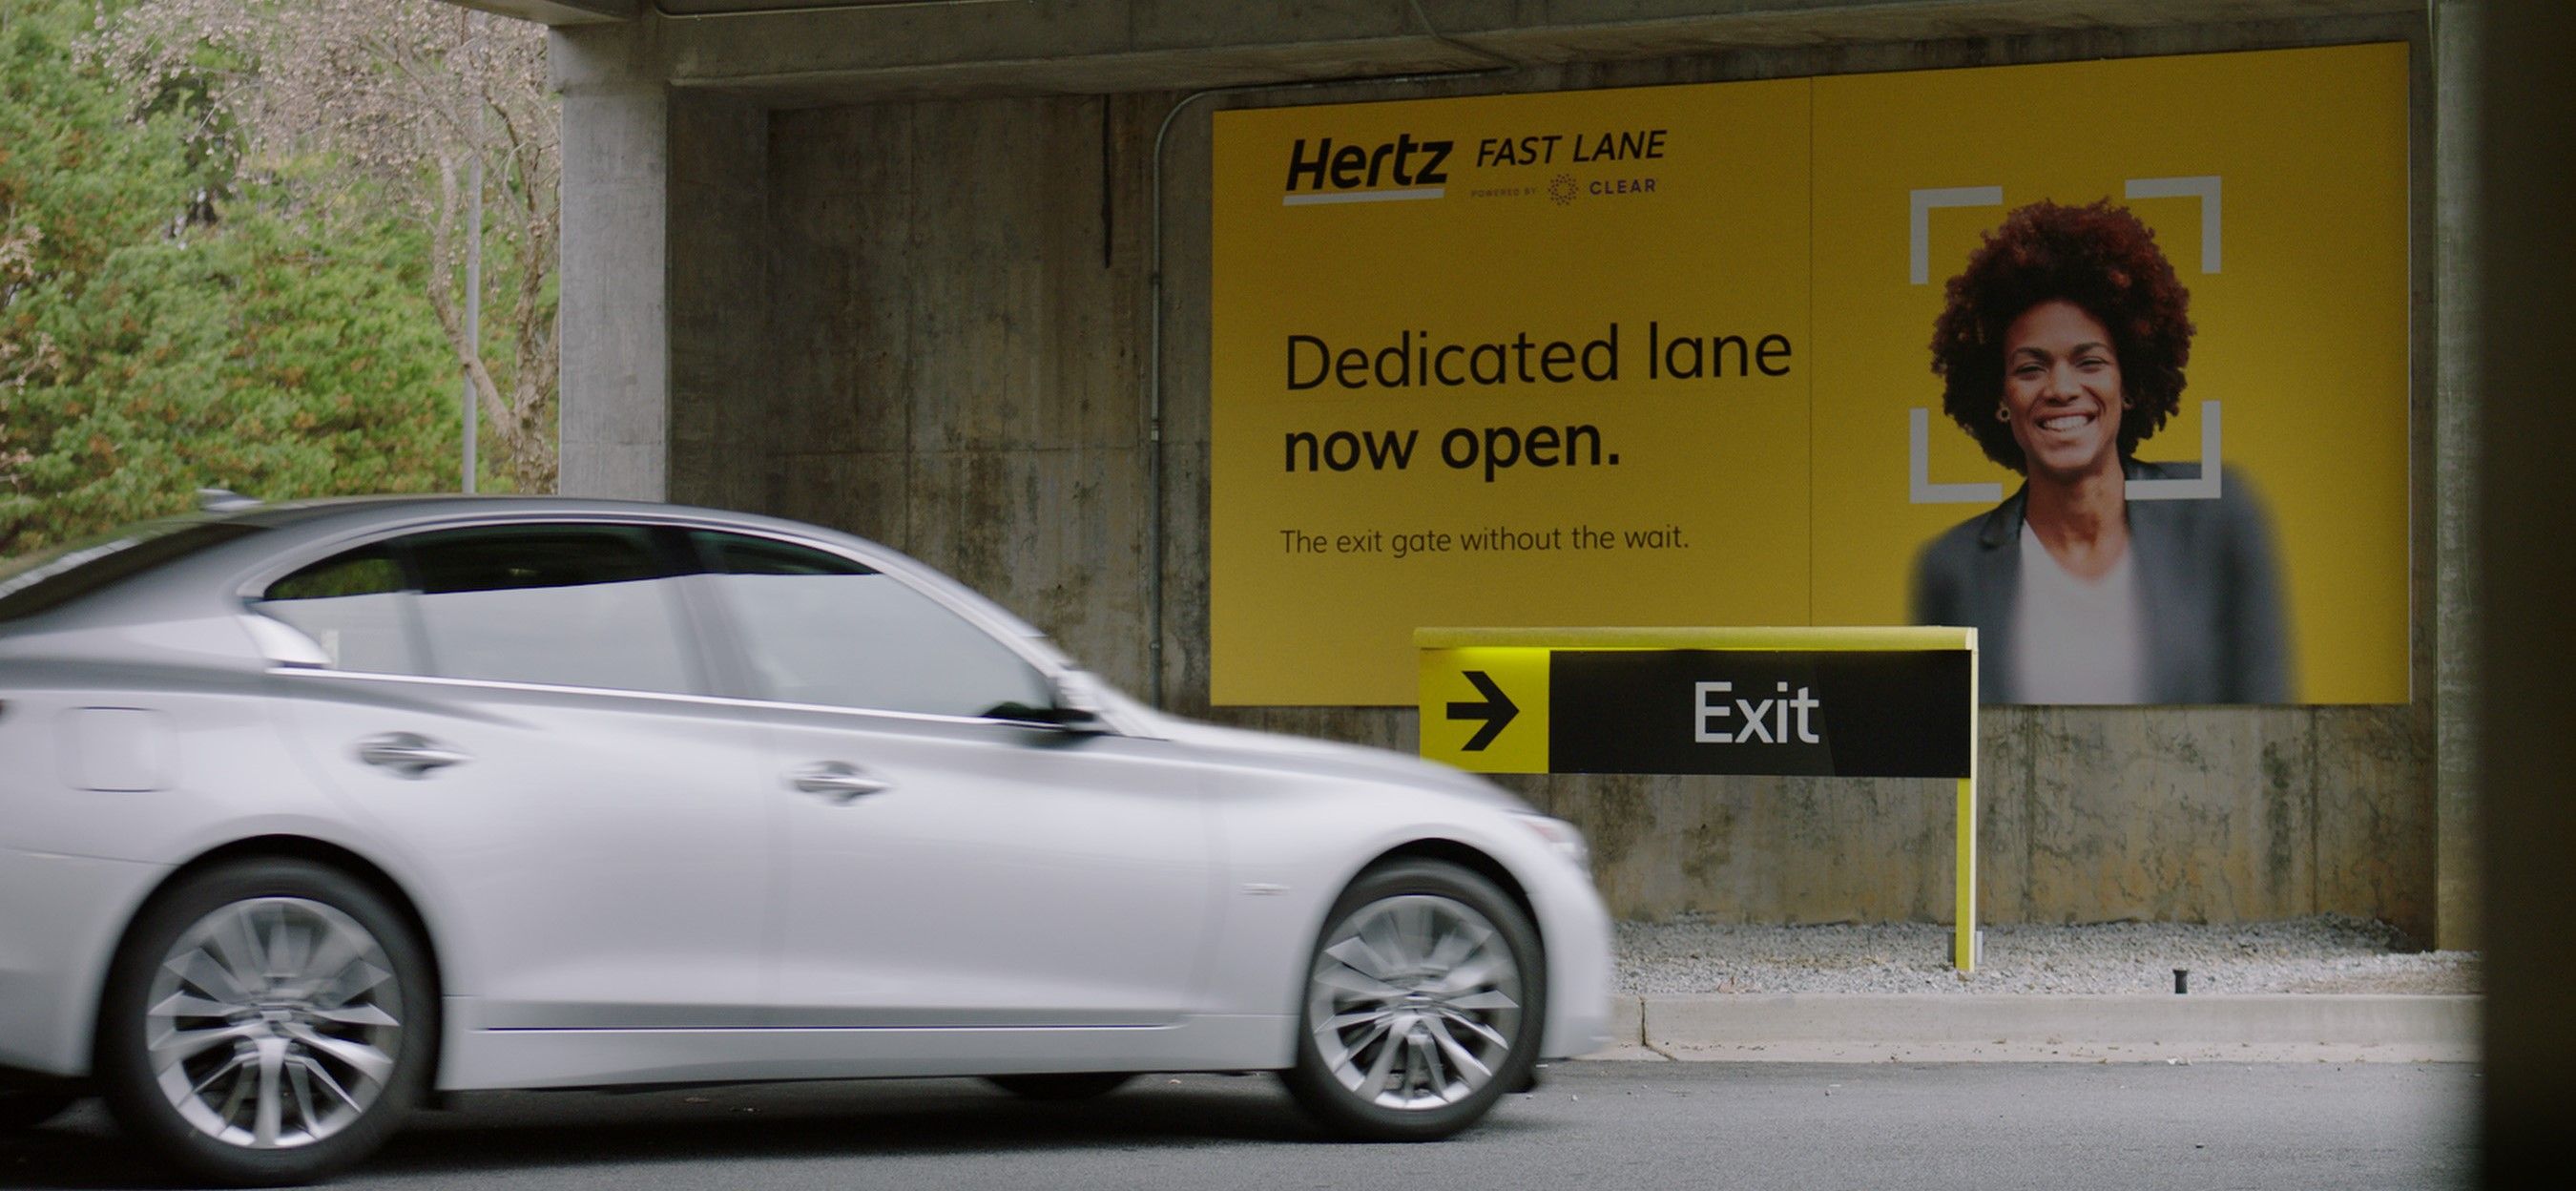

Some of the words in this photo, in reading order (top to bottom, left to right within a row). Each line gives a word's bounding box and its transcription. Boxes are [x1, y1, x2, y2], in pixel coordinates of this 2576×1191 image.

[1285, 134, 1454, 191] Hertz
[1477, 136, 1562, 167] FAST
[1573, 130, 1668, 163] LANE
[1471, 188, 1518, 198] POWERED
[1524, 186, 1537, 197] BY
[1589, 178, 1656, 196] CLEAR
[1286, 324, 1620, 390] Dedicated
[1650, 322, 1793, 380] lane
[1285, 429, 1419, 472] now
[1441, 424, 1620, 482] open.
[1280, 529, 1328, 554] The
[1336, 529, 1383, 554] exit
[1391, 531, 1452, 558] gate
[1460, 526, 1561, 552] without
[1571, 526, 1615, 550] the
[1624, 524, 1690, 549] wait.
[1694, 681, 1819, 743] Exit
